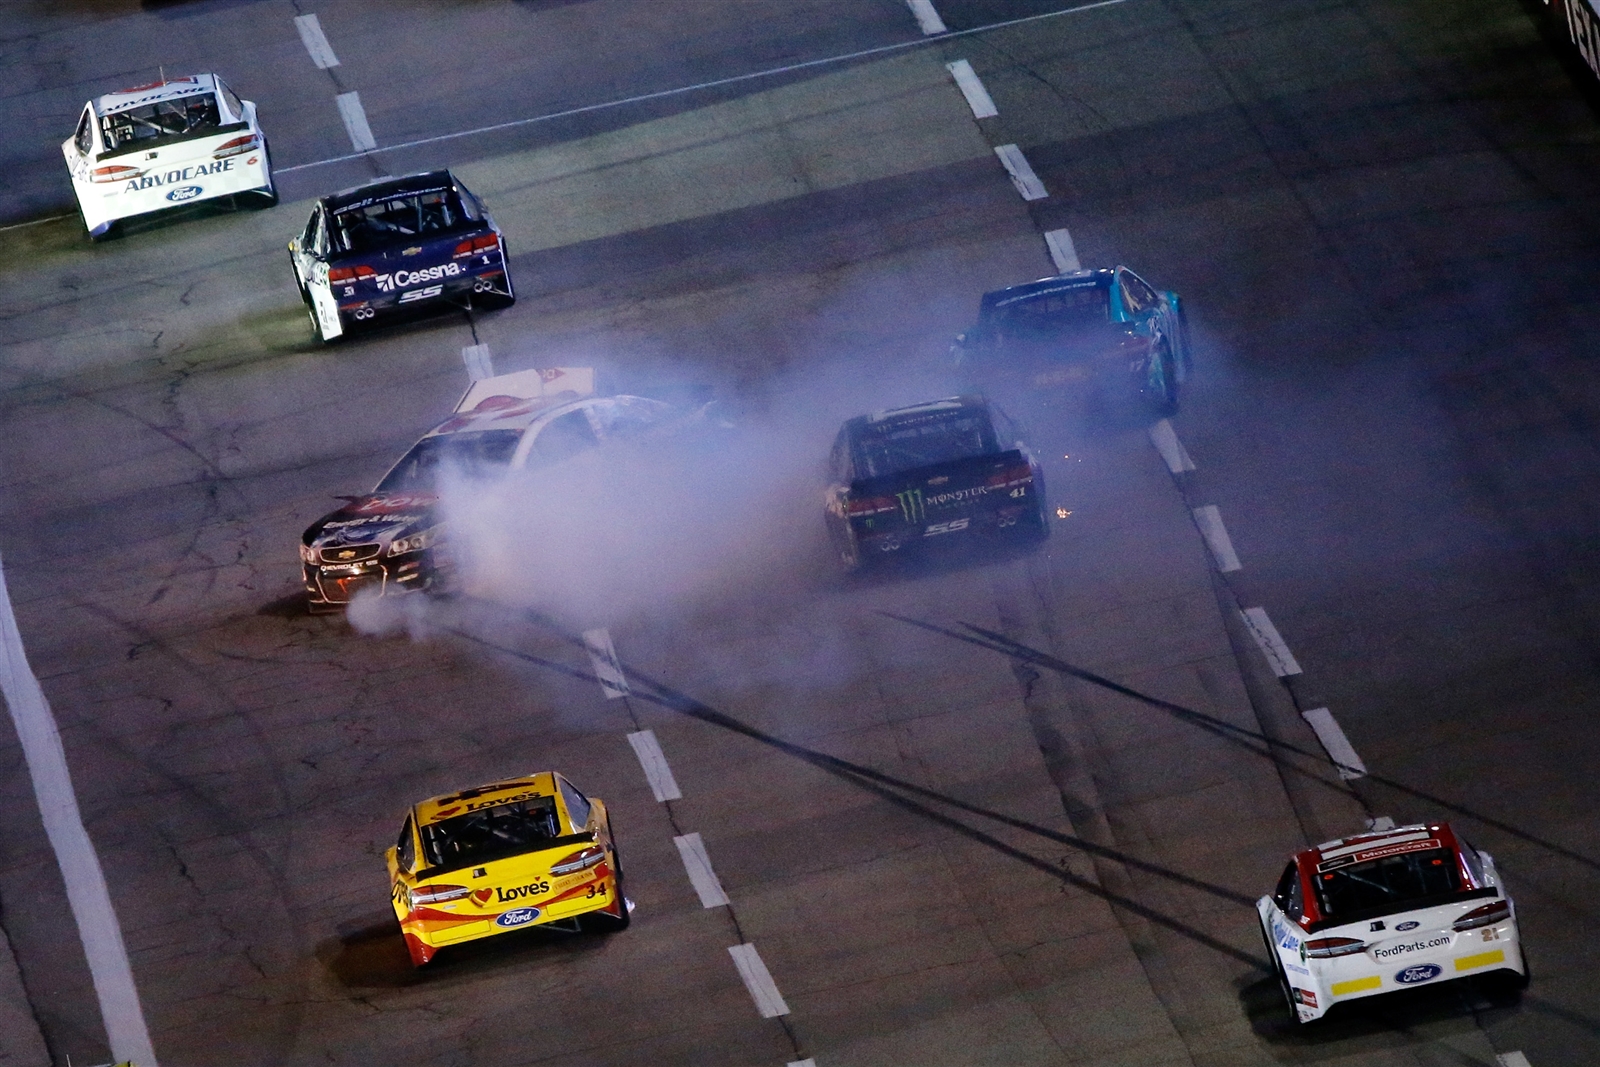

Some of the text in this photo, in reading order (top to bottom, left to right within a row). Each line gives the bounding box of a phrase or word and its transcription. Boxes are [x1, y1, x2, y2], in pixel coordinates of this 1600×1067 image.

[247, 156, 258, 165] 6
[124, 158, 235, 194] ADVOCARE
[482, 255, 490, 265] 1
[395, 262, 459, 287] Cessna
[399, 284, 444, 304] SS
[1009, 486, 1026, 499] 41
[1362, 842, 1431, 859] Motorcraft
[586, 882, 606, 899] 34
[504, 910, 532, 925] Ford
[1481, 928, 1499, 942] 21
[1374, 936, 1450, 959] FordParts.com
